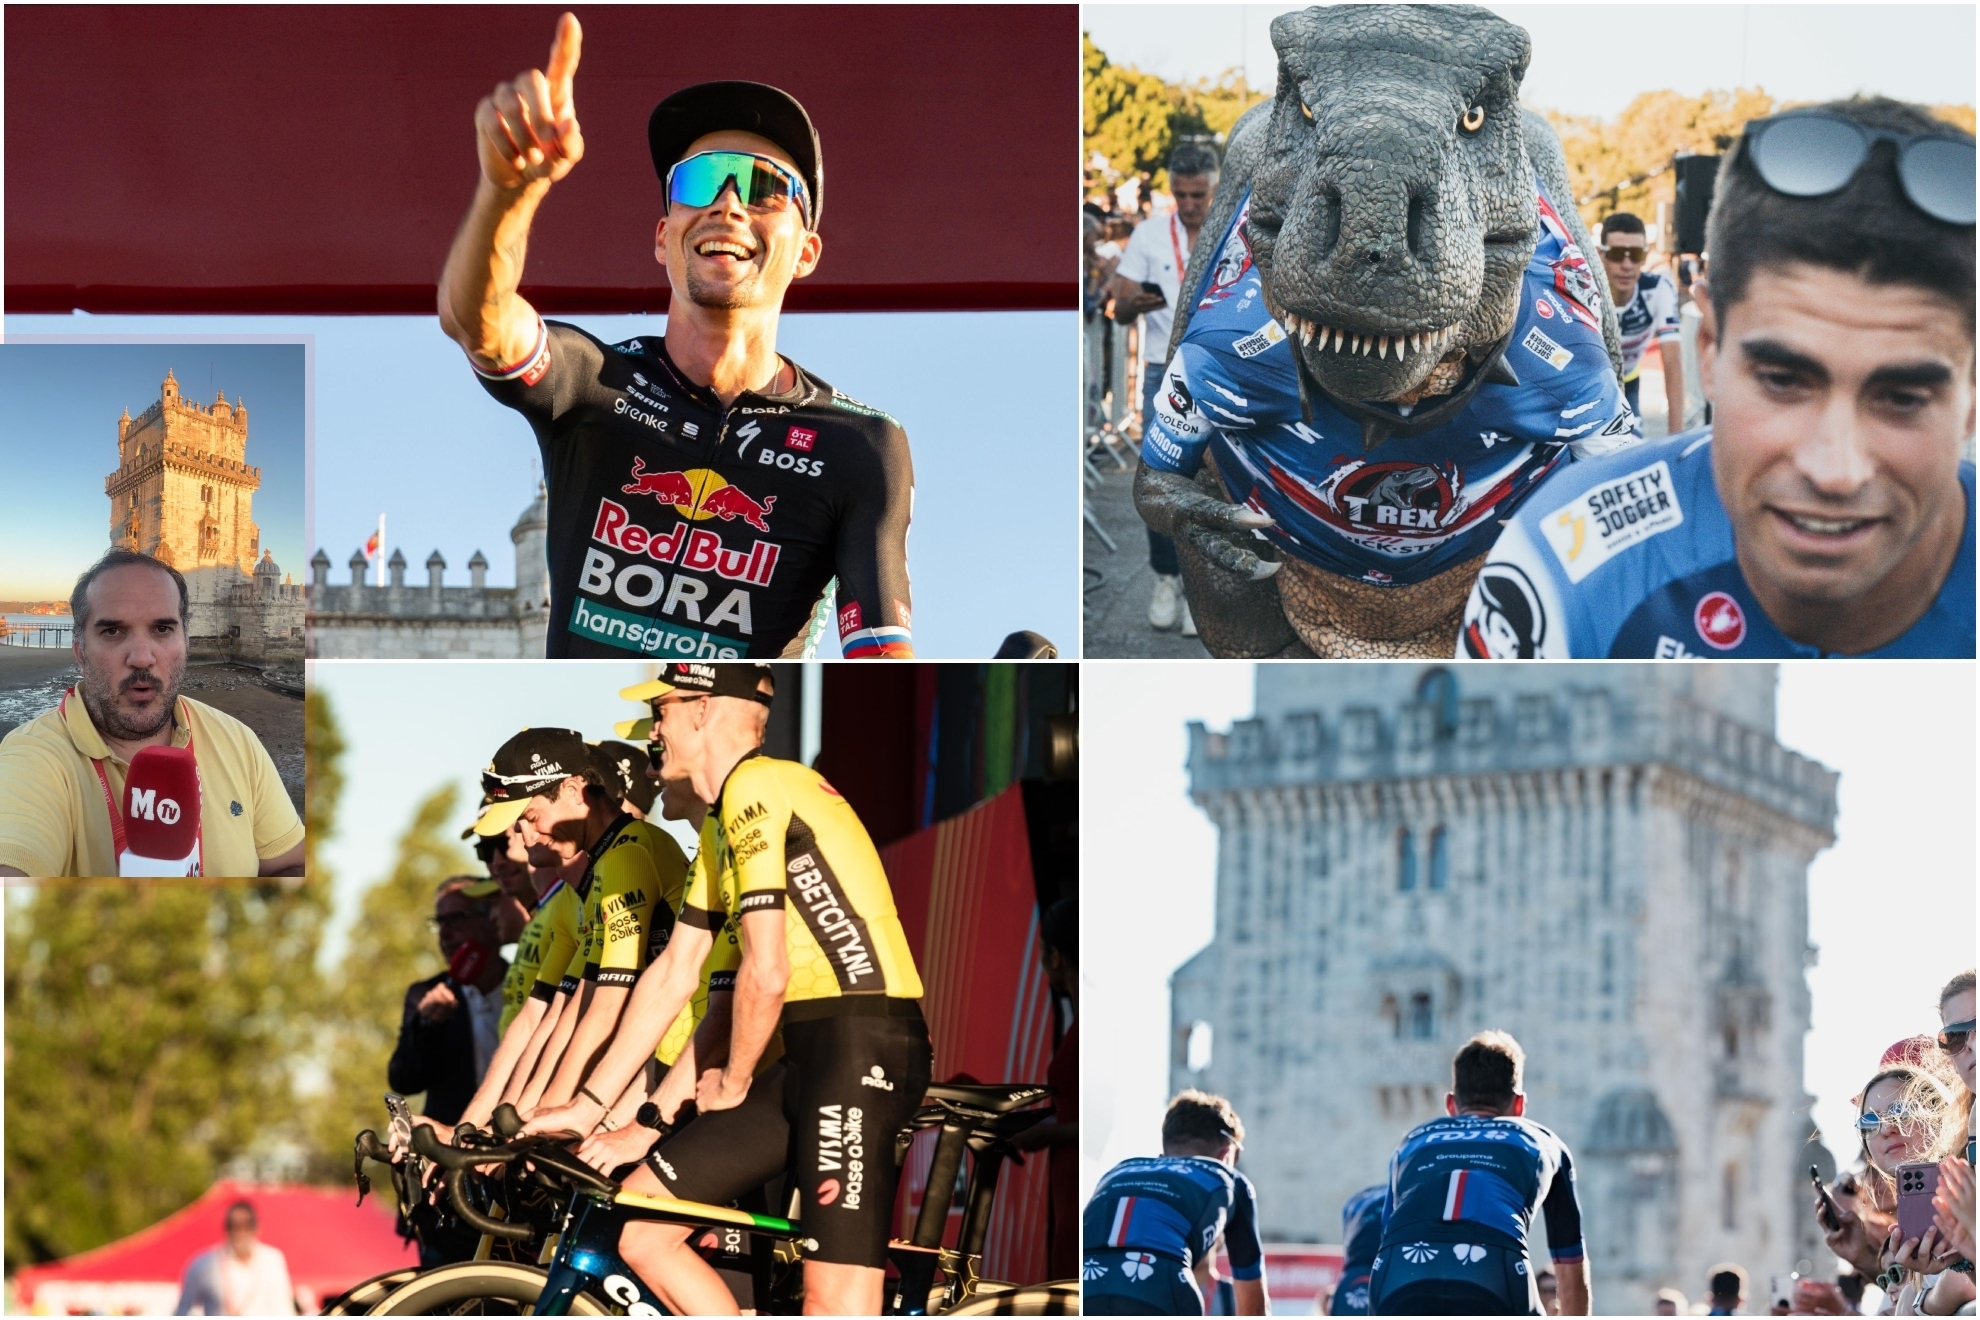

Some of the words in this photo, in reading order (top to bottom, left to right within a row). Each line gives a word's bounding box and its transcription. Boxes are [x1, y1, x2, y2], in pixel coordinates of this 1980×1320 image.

[1237, 334, 1267, 352] JOGGER
[1243, 340, 1270, 357] SAFETY
[1525, 340, 1552, 360] SAFETY
[1529, 332, 1555, 354] JOGGER
[614, 398, 668, 432] grenke
[742, 404, 791, 415] BORA
[790, 438, 809, 449] TAL
[791, 428, 813, 441] ÖTZ
[758, 448, 825, 477] BOSS
[1588, 469, 1661, 515] SAFETY
[1343, 495, 1369, 522] T
[1377, 505, 1438, 529] REX
[1596, 491, 1670, 537] JOGGER
[592, 497, 689, 564] Red
[680, 528, 782, 587] Bull
[578, 546, 753, 635] BORA
[574, 597, 738, 659] hansgrohe
[839, 608, 857, 625] ÖTZ
[841, 621, 858, 635] TAL
[689, 663, 715, 679] VISMA
[534, 762, 562, 777] VISMA
[131, 787, 156, 821] M
[162, 804, 177, 820] TV
[729, 801, 768, 835] VISMA
[607, 888, 647, 914] VISMA
[607, 912, 639, 933] lease
[793, 868, 875, 985] BETCITY.NL
[817, 1104, 843, 1172] VISMA
[843, 1106, 864, 1145] bike
[1425, 1130, 1481, 1144] FDJ
[841, 1159, 864, 1210] lease
